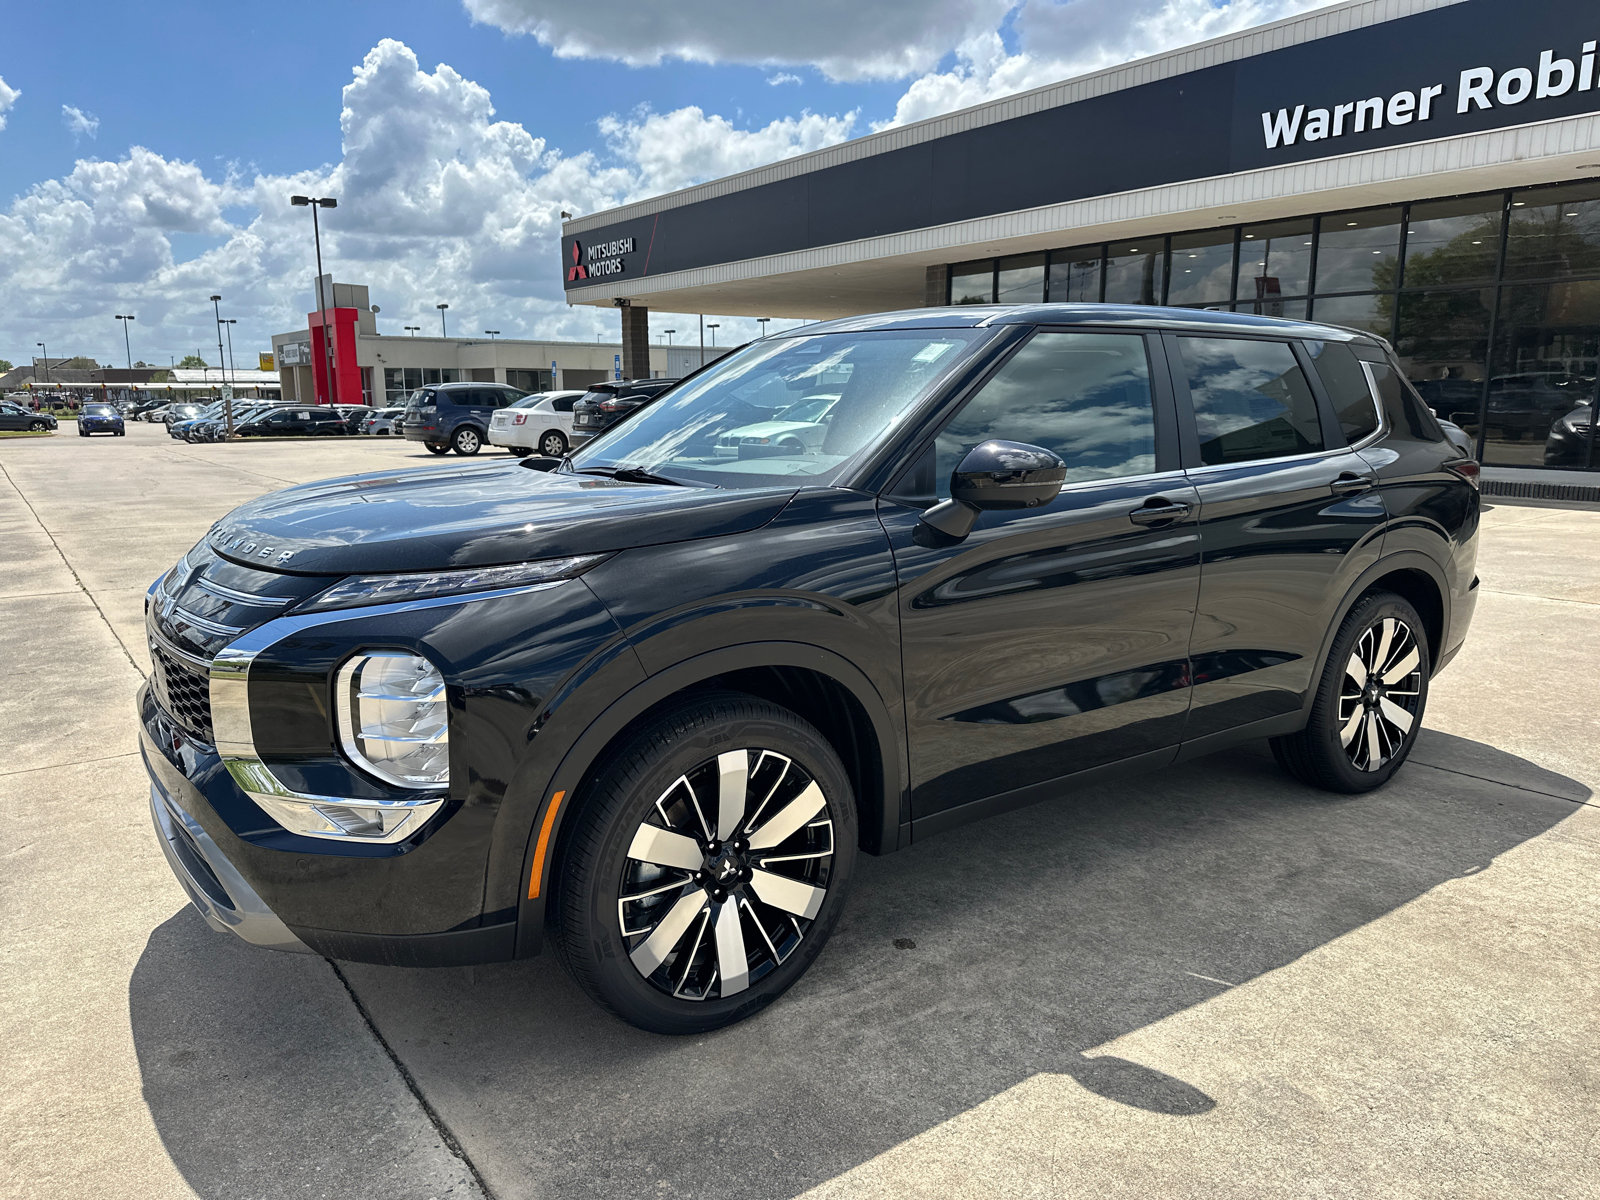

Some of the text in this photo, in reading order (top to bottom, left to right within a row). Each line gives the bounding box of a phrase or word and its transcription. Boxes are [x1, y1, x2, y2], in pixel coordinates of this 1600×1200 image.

[1261, 39, 1600, 149] Warner Robi
[587, 237, 633, 261] MITSUBISHI
[588, 257, 622, 278] MOTORS
[207, 520, 295, 563] TLANDER
[600, 795, 645, 895] ROADIAN
[803, 878, 847, 959] NEXEN
